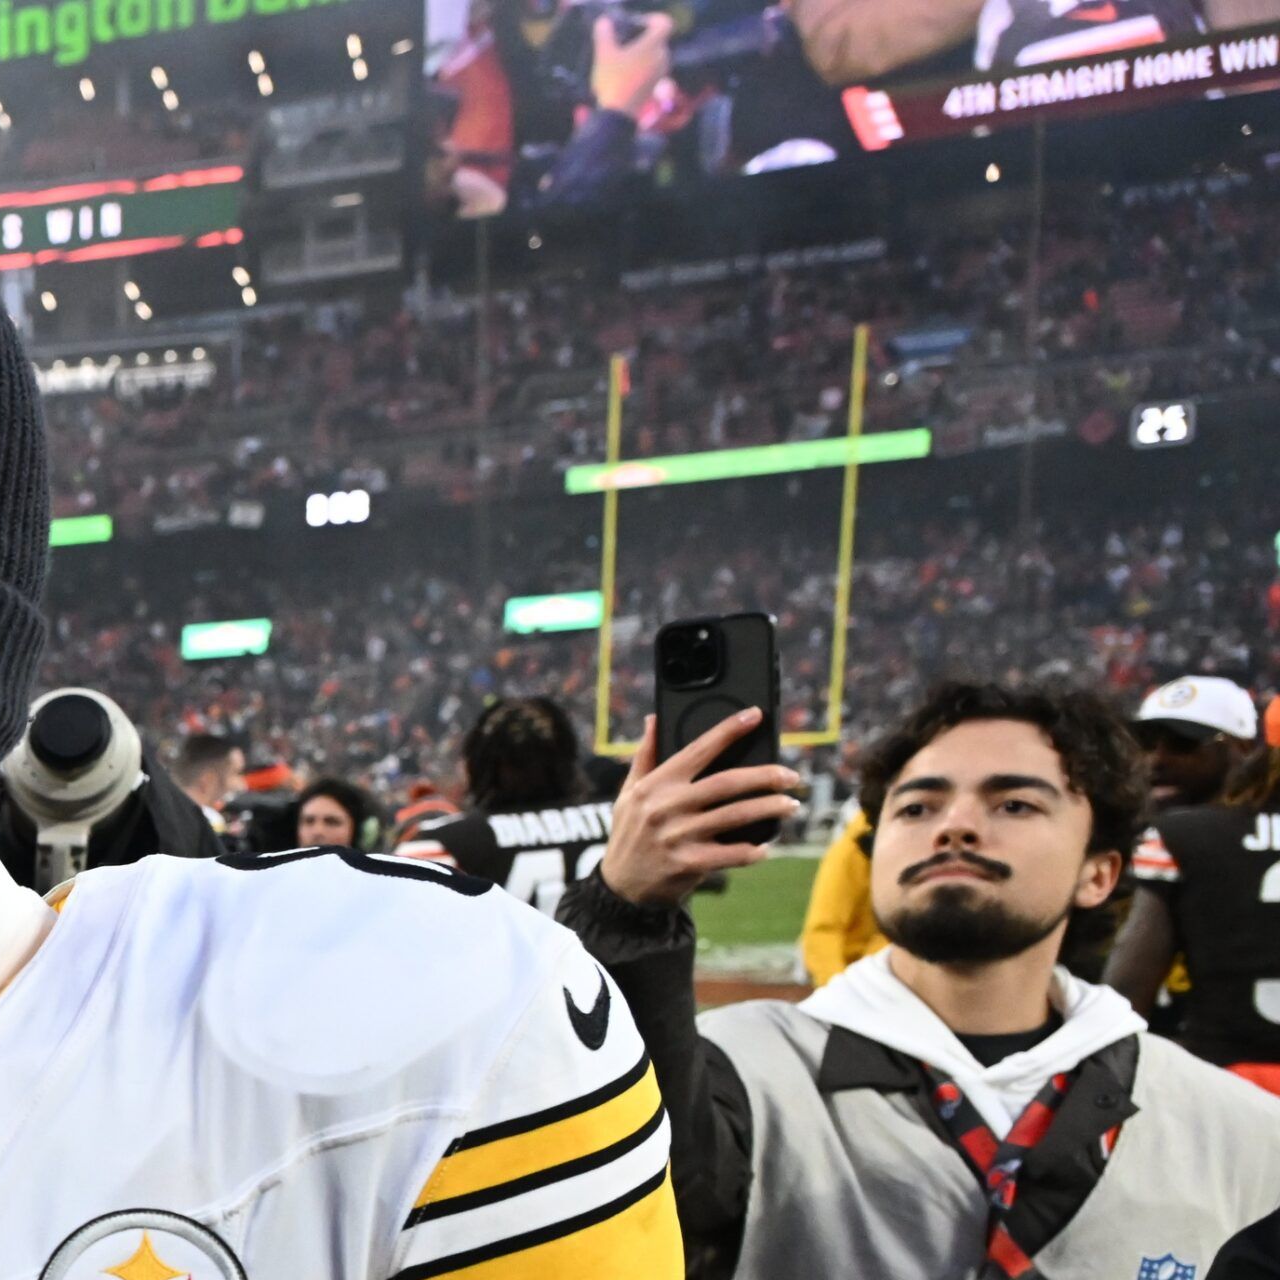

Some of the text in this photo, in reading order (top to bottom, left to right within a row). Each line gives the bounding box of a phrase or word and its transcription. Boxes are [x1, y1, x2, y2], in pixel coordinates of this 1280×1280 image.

[942, 35, 1279, 119] 4TH STRAIGHT HOME WIN
